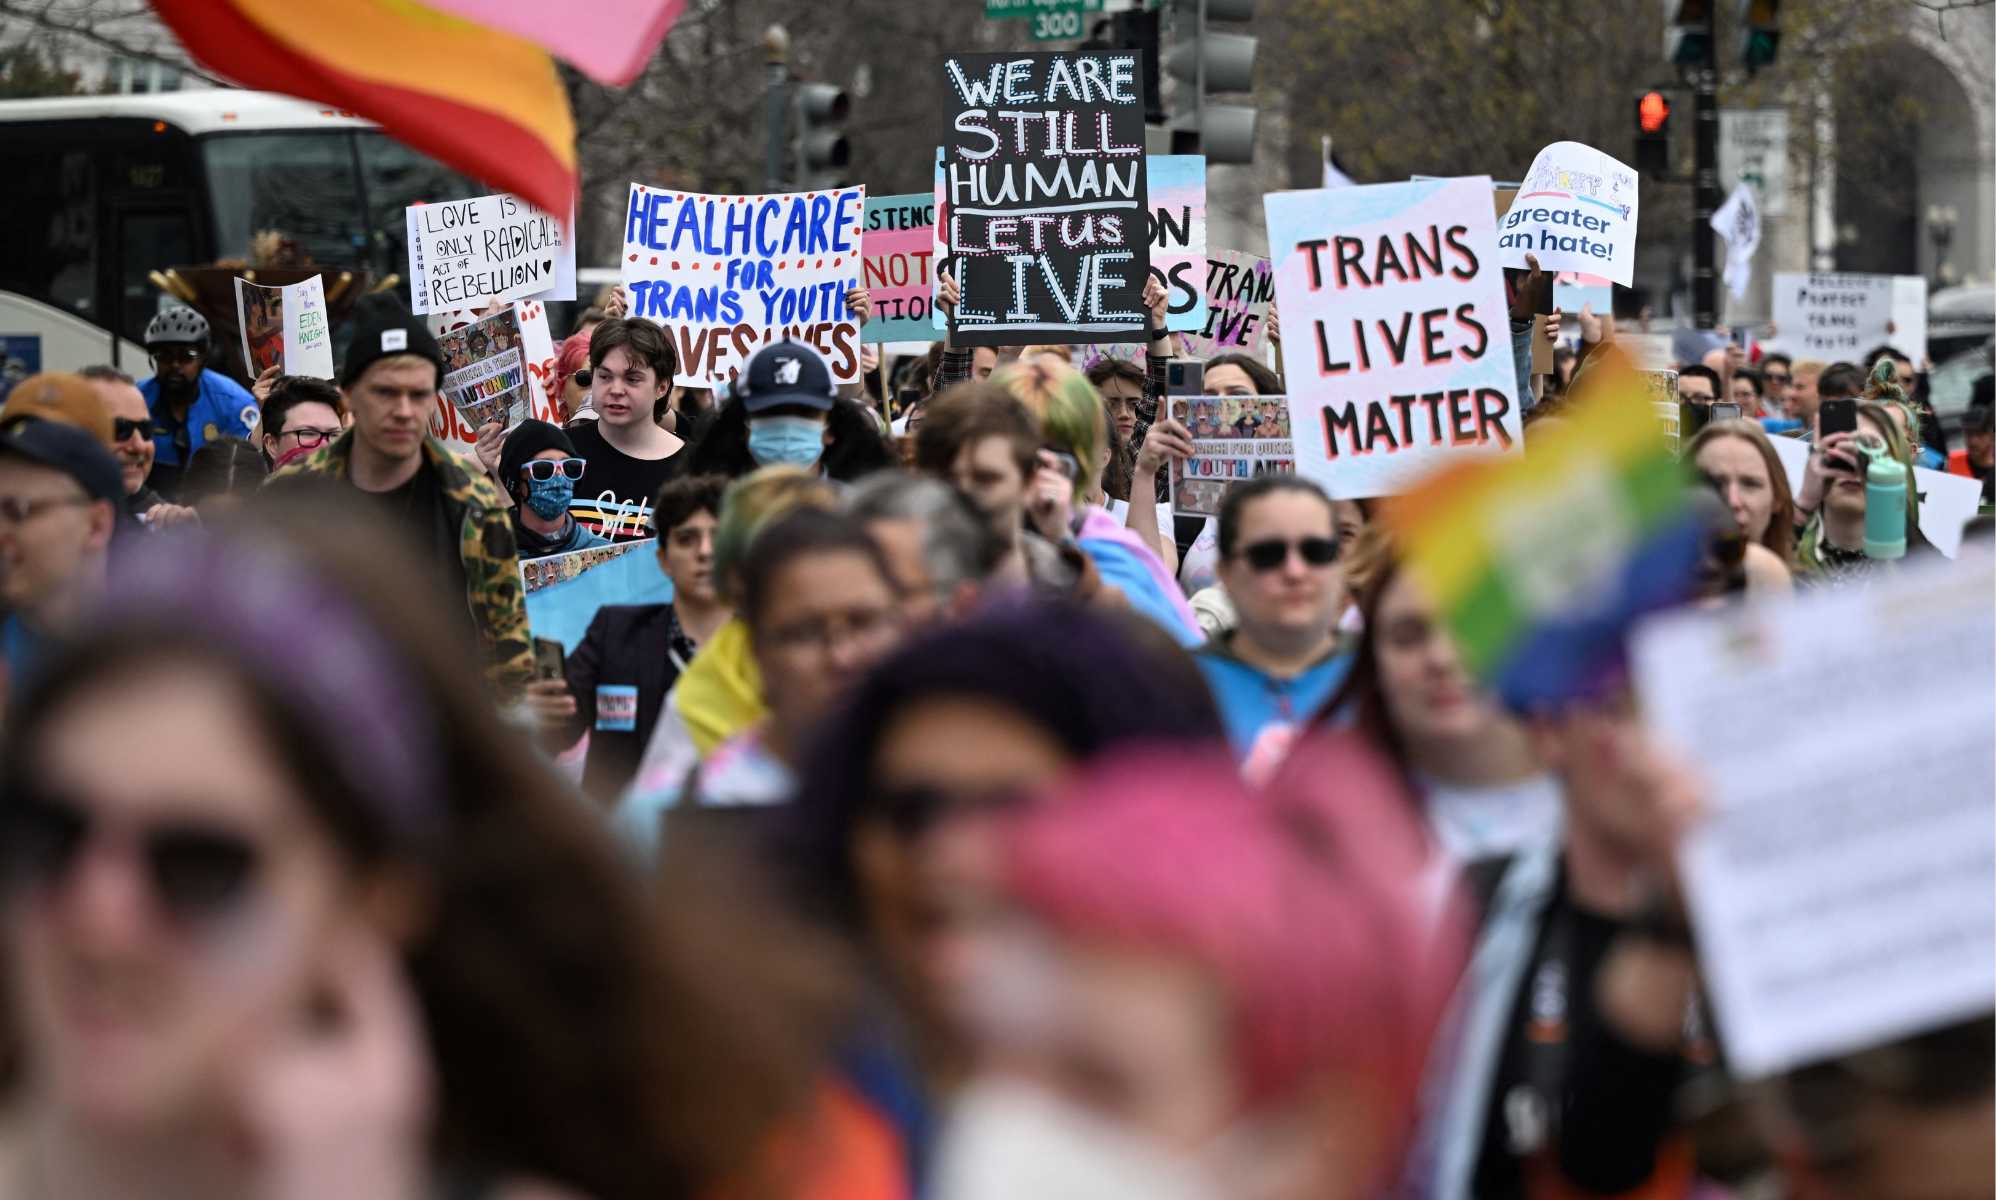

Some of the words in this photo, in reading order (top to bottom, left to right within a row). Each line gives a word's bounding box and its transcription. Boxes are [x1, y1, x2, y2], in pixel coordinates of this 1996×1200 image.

[1036, 12, 1079, 37] 300
[947, 58, 1037, 104] WE
[1045, 56, 1136, 103] ARE
[954, 110, 1142, 162] STILL
[949, 157, 1138, 206] HUMAN
[425, 201, 480, 233] LOVE
[499, 197, 517, 219] IS
[627, 189, 859, 256] HEALHCARE
[863, 205, 934, 232] STENC
[951, 214, 1056, 255] LET
[1506, 208, 1611, 234] greater
[436, 234, 474, 256] ONLY
[483, 216, 554, 262] RADICAL
[1296, 225, 1479, 292] TRANS
[1540, 230, 1613, 261] hate!
[432, 259, 538, 306] REBELLION
[433, 262, 450, 276] ACT
[457, 258, 469, 269] OF
[727, 258, 774, 290] FOR
[863, 251, 933, 289] NOT
[954, 250, 1145, 323] LIVE
[1206, 260, 1275, 303] TRAN
[300, 311, 322, 329] EDEN
[629, 280, 744, 325] TRANS
[760, 278, 856, 325] YOUTH
[298, 326, 325, 345] KNIGHT
[663, 323, 758, 382] VES
[1314, 303, 1488, 377] LIVES
[1320, 387, 1514, 460] MATTER
[1187, 458, 1248, 477] YOUTH
